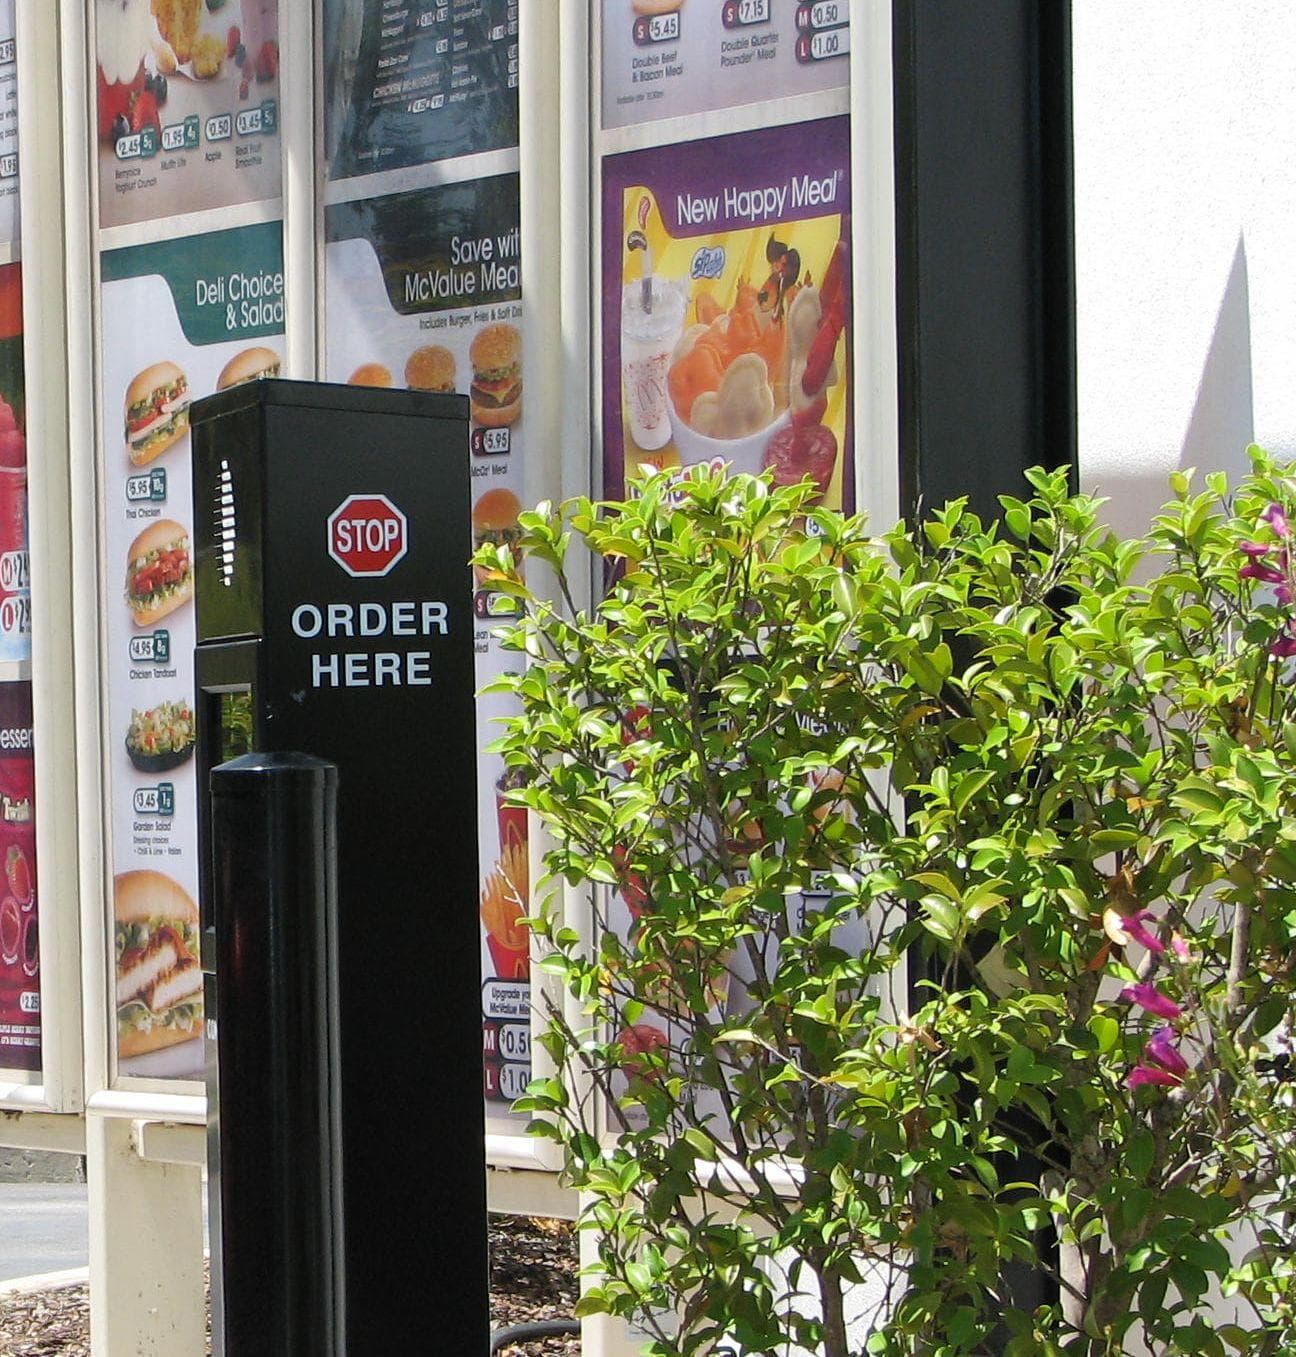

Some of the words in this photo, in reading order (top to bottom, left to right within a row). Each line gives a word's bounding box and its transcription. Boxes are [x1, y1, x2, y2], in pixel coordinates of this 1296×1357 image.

[637, 26, 644, 39] S
[798, 10, 808, 27] M
[800, 41, 806, 57] L
[677, 194, 720, 226] New
[724, 185, 787, 222] Happy
[451, 235, 493, 266] Save
[498, 228, 519, 258] wit
[196, 276, 225, 307] Deli
[229, 270, 283, 302] Choice
[405, 268, 476, 303] McValue
[481, 261, 519, 291] Mea
[226, 307, 237, 331] &
[241, 297, 283, 328] Salad
[336, 519, 400, 553] STOP
[291, 602, 449, 638] ORDER
[312, 652, 432, 688] HERE
[491, 987, 520, 1001] Upgrade
[483, 1029, 495, 1050] M
[501, 1030, 531, 1054] $0.5
[486, 1069, 493, 1090] L
